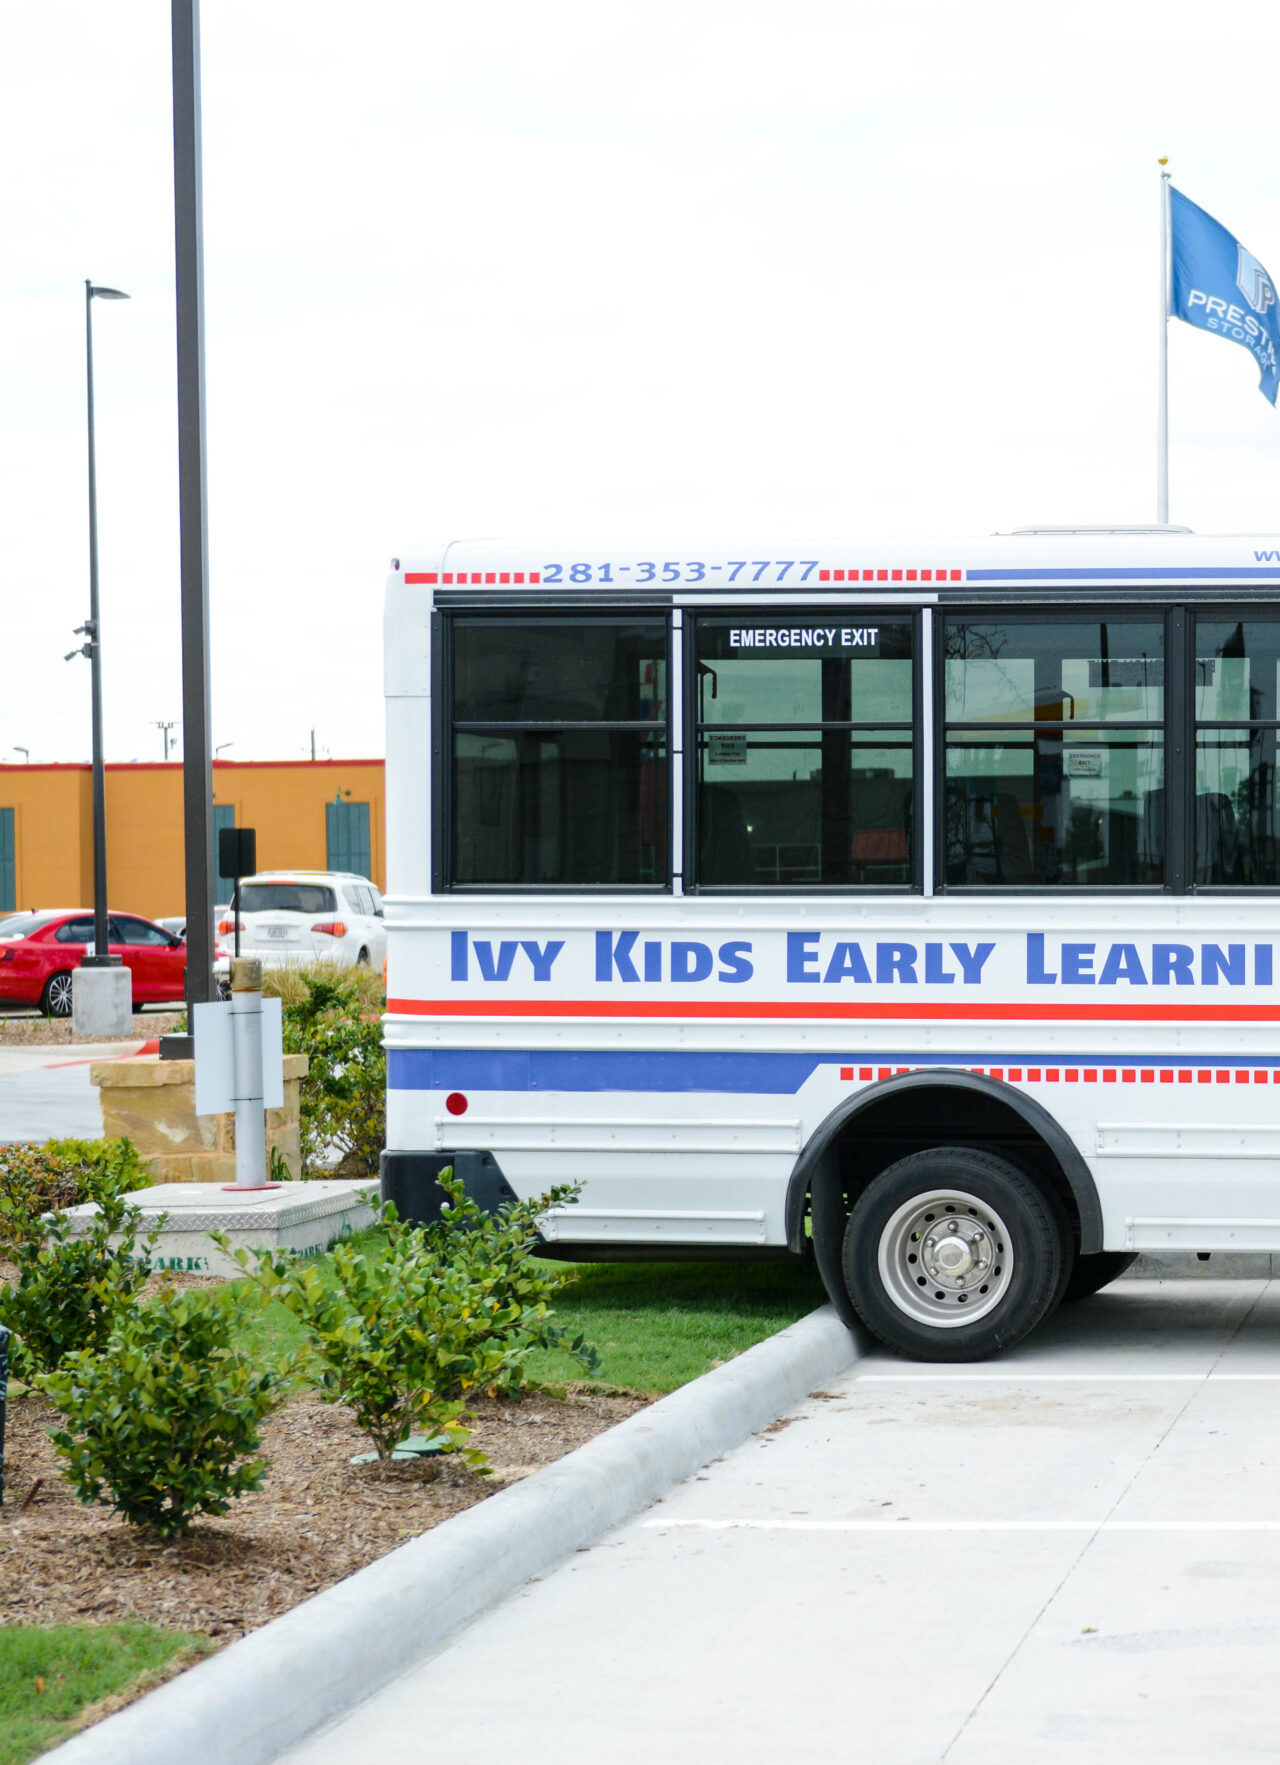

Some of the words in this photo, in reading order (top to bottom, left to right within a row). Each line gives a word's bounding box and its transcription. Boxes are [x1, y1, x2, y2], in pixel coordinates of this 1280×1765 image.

[1188, 290, 1276, 376] PRESTI
[543, 561, 820, 583] 281-353-7777
[730, 629, 836, 646] EMERGENCY
[841, 629, 878, 645] EXIT
